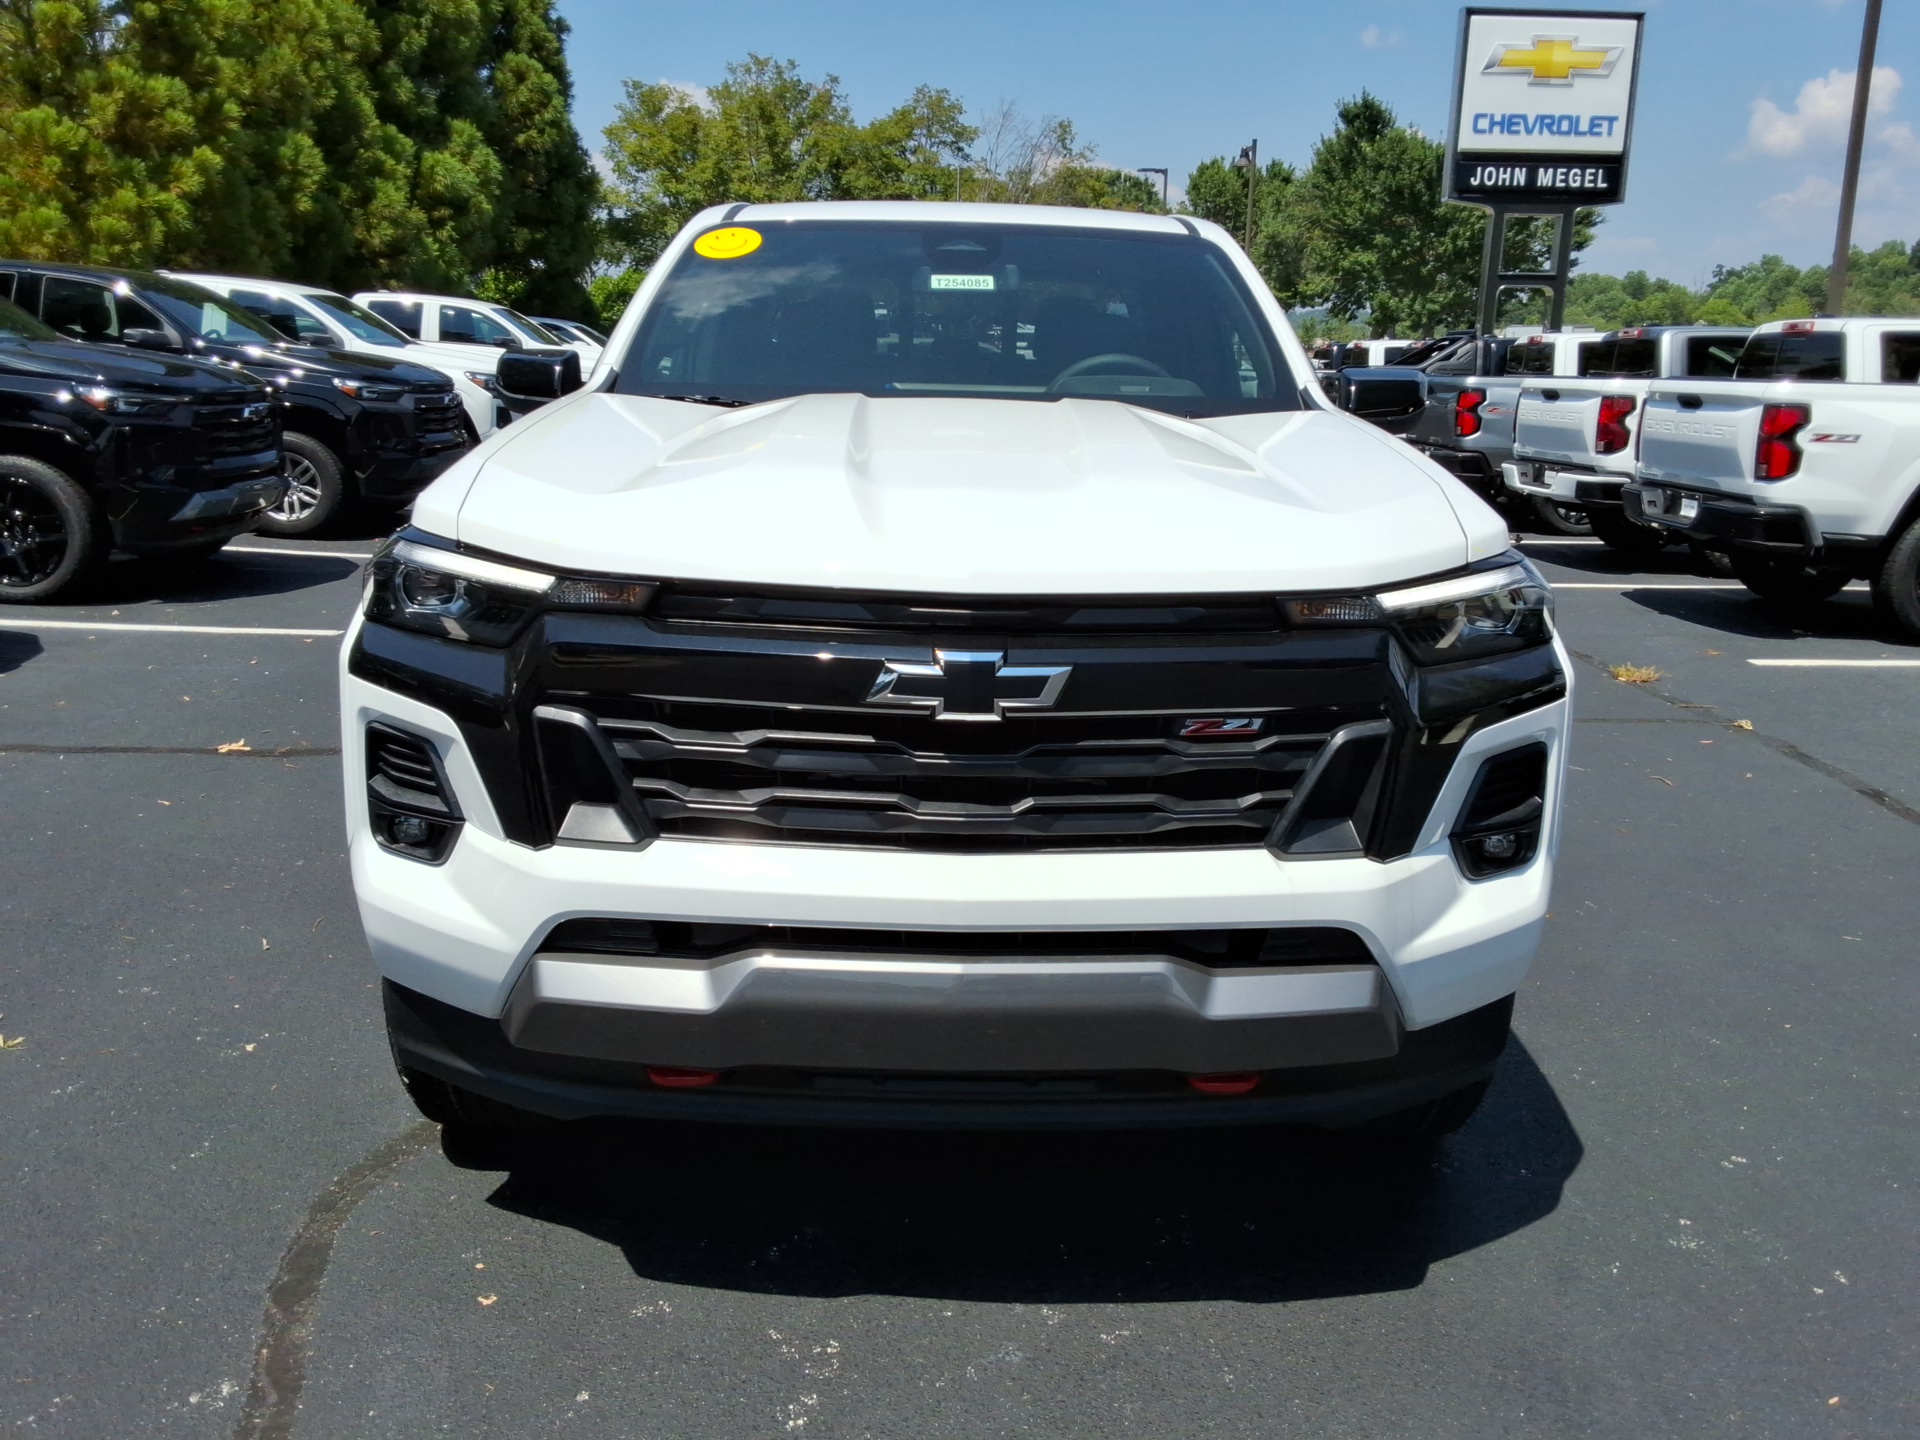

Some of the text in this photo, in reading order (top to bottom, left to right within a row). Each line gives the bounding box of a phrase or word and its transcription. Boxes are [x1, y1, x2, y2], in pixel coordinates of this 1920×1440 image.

[1472, 113, 1619, 137] CHEVROLET
[1470, 166, 1608, 188] JOHN MEGEL
[935, 278, 989, 287] T254085
[1179, 718, 1264, 736] Z71
